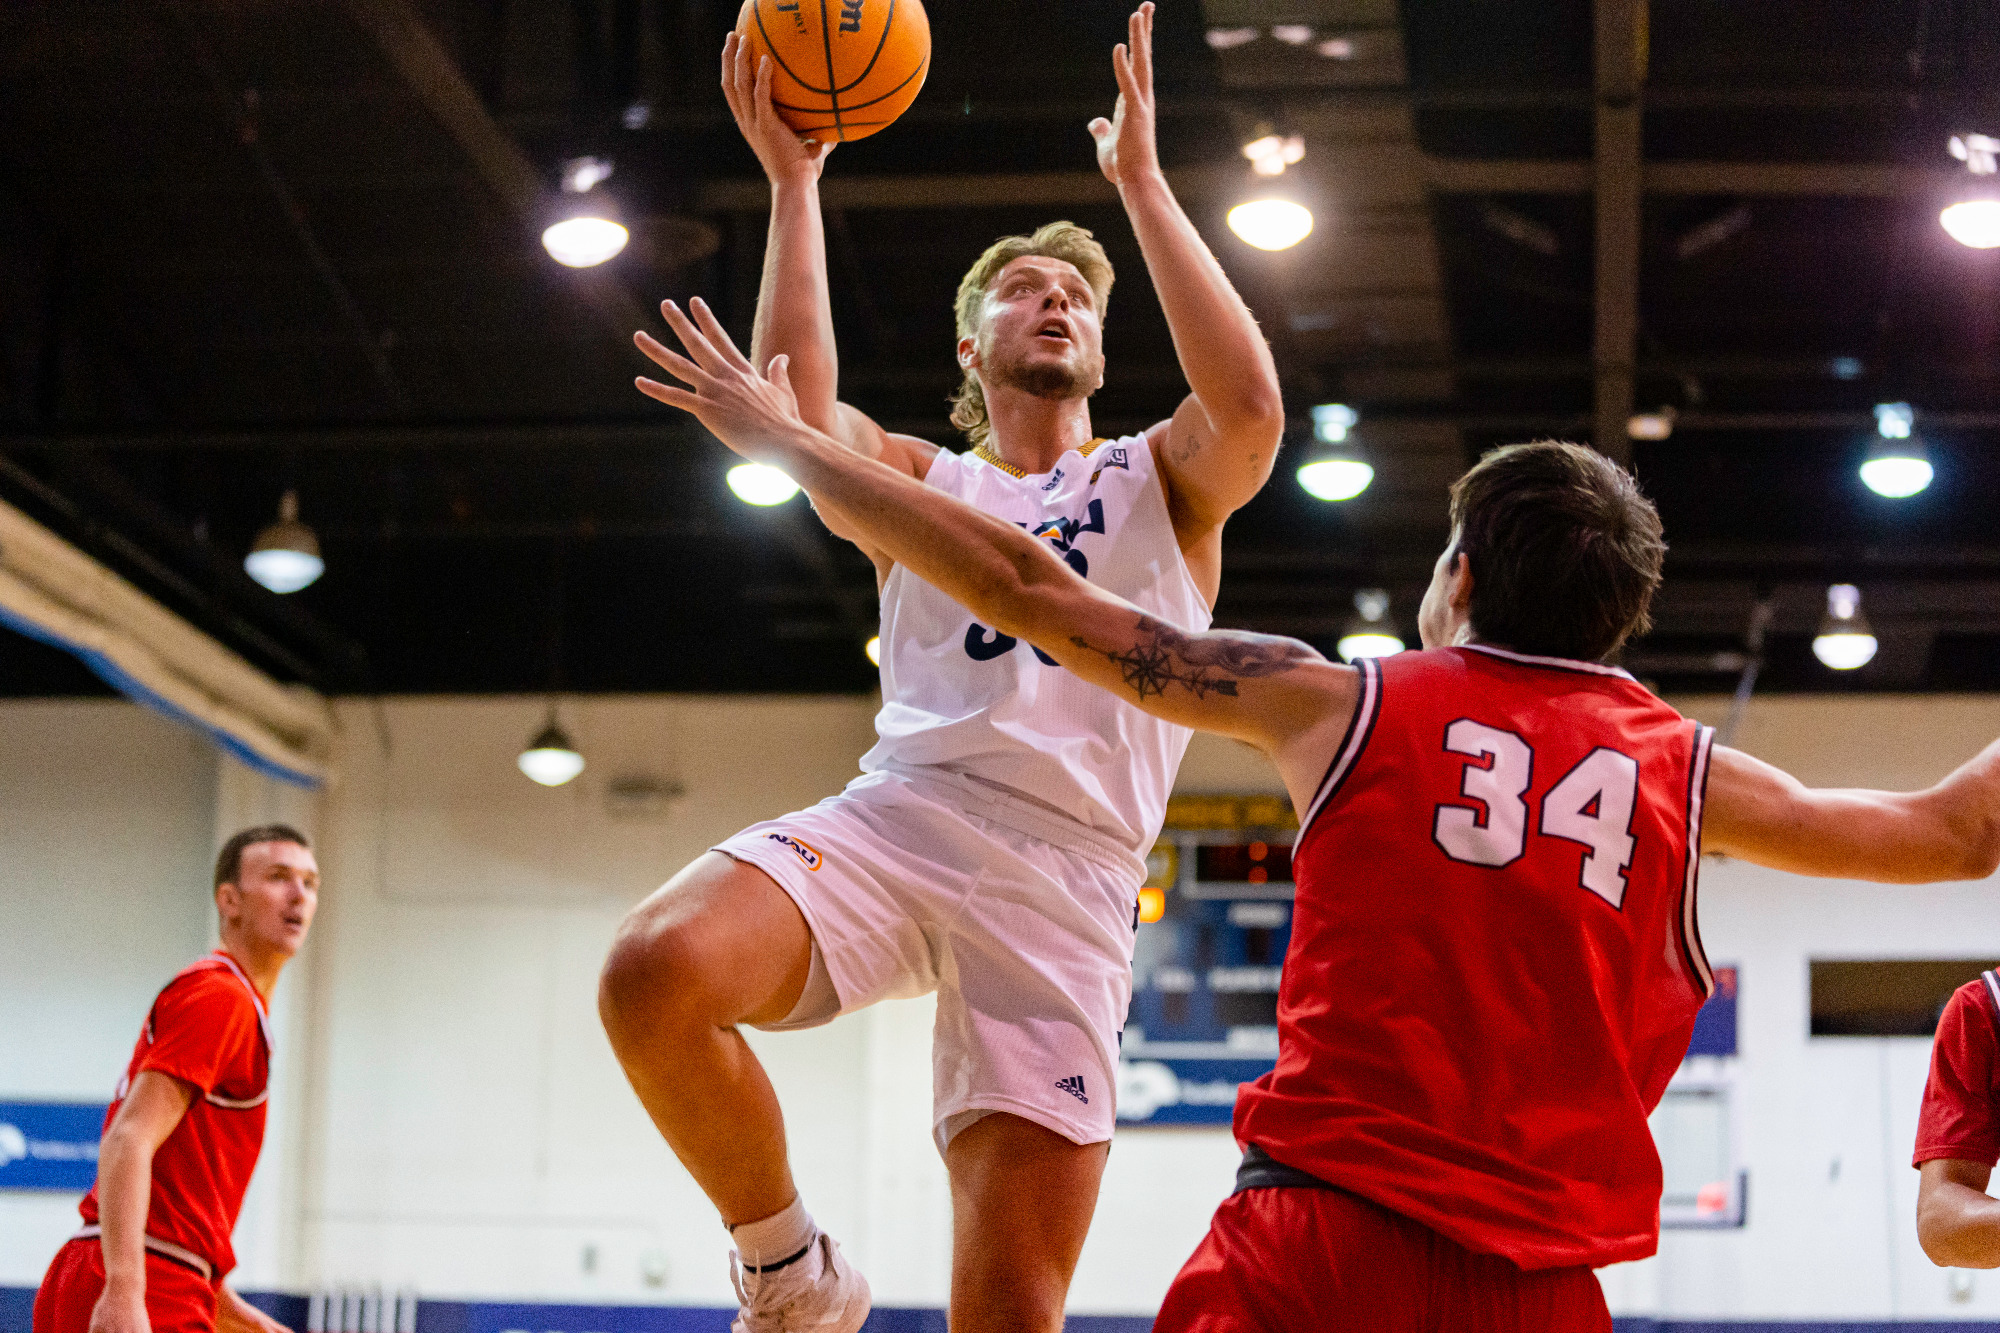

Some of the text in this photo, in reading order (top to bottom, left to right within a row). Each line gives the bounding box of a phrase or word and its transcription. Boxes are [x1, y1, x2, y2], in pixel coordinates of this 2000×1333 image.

[1431, 716, 1640, 912] 34
[768, 834, 816, 865] NAU
[1055, 1081, 1089, 1104] adidas
